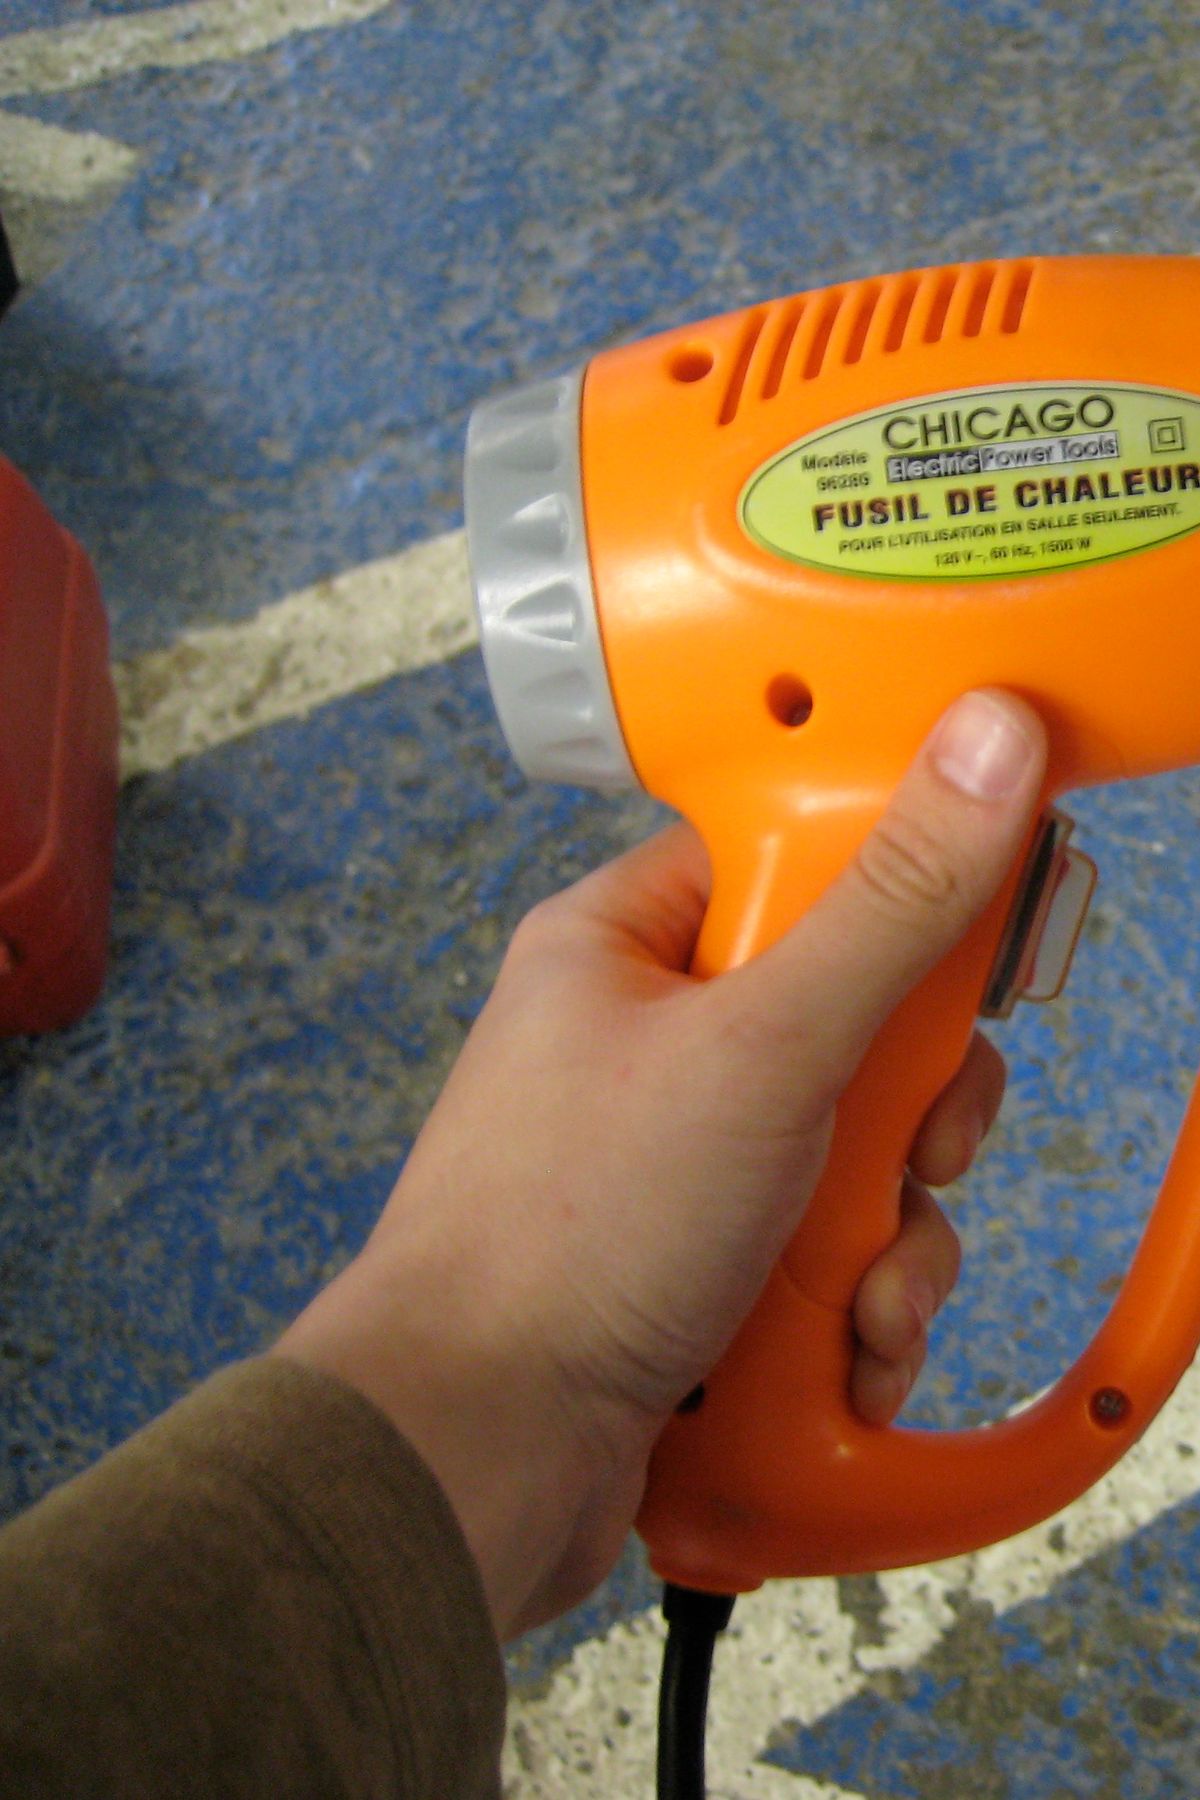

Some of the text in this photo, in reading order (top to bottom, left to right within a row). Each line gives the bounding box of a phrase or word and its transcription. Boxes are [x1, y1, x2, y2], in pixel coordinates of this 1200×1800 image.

[881, 394, 1114, 450] CHICAGO
[889, 436, 1117, 484] Electric Power Tools
[813, 493, 929, 532] FUSIL
[945, 485, 997, 516] DE
[838, 502, 1181, 554] POUR L'UTILISATION EN SALLE SEULEMENT.
[1040, 539, 1073, 555] 1500
[1077, 536, 1092, 549] W
